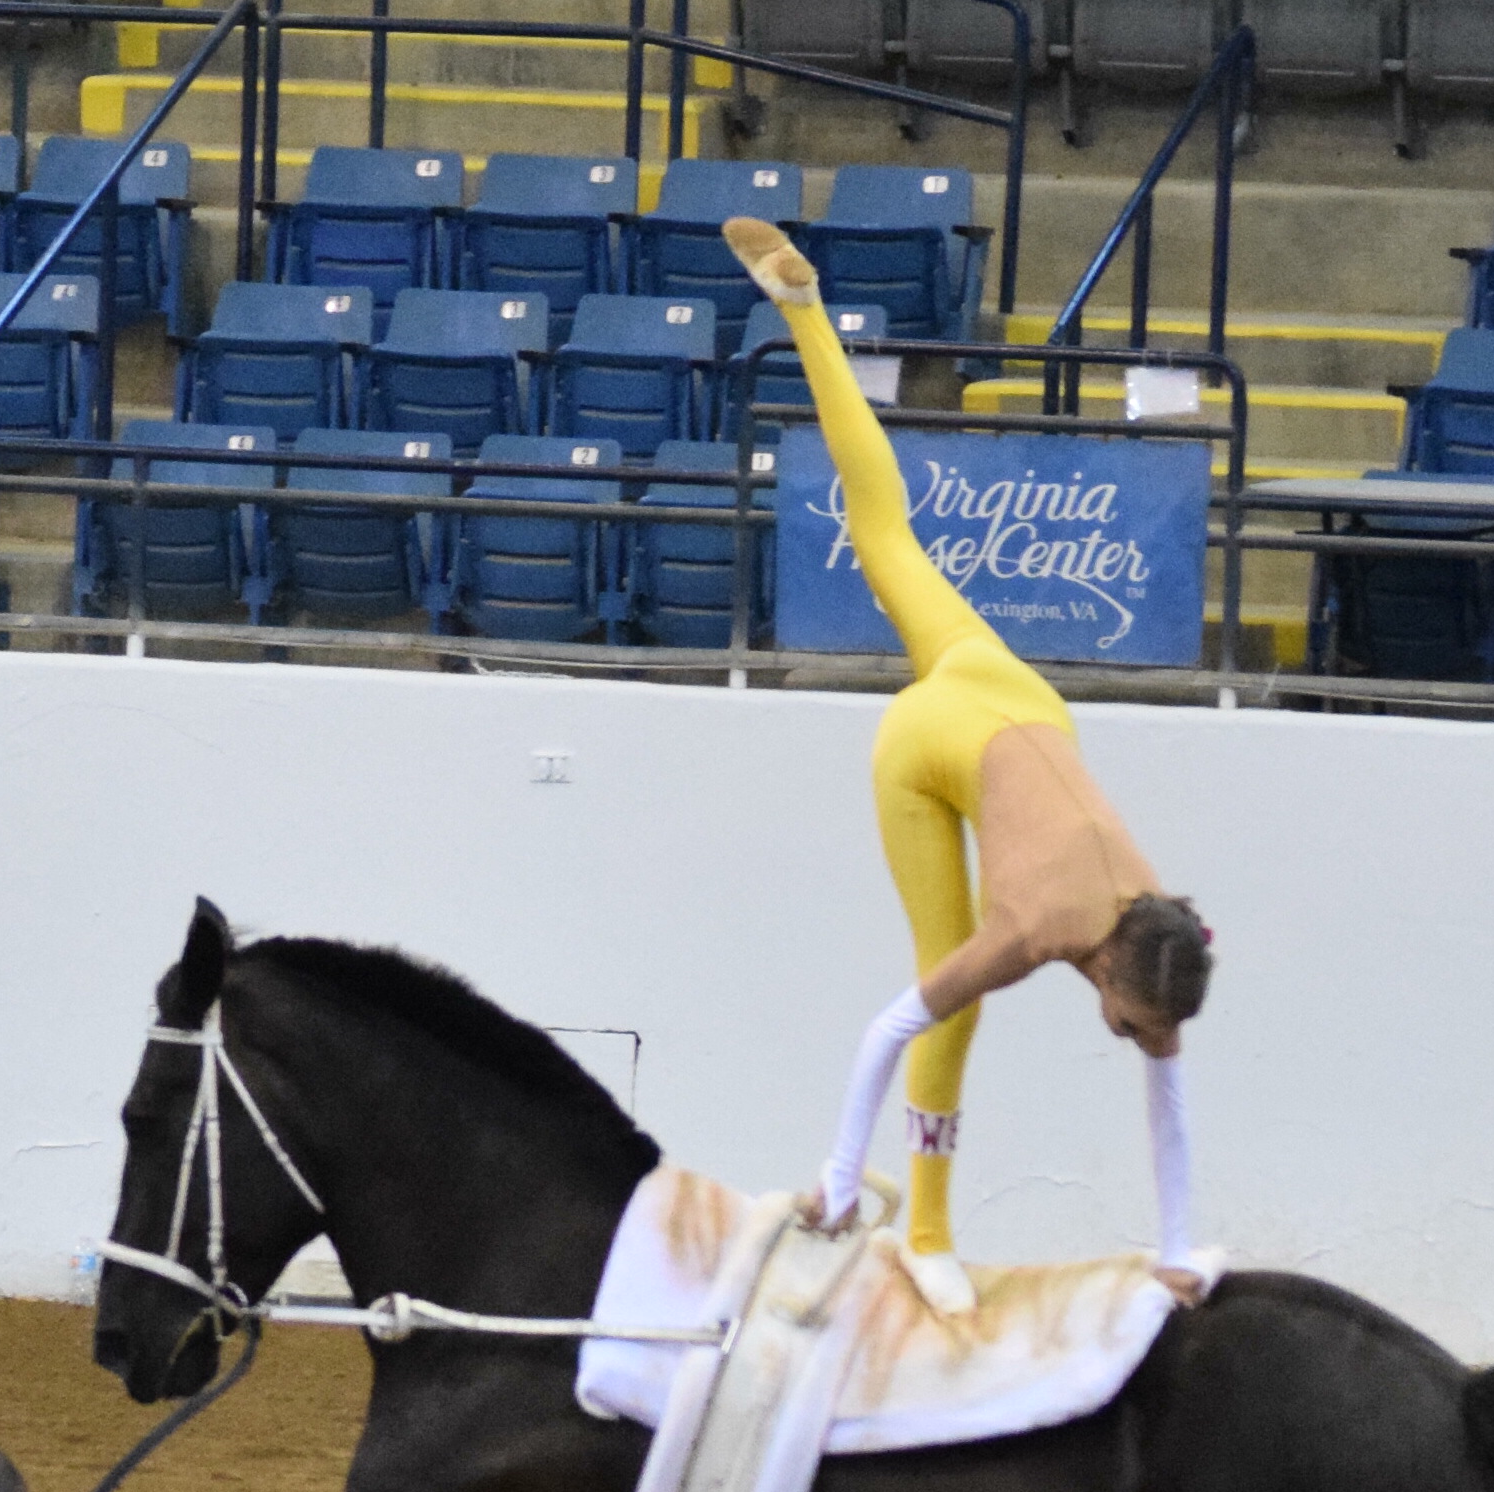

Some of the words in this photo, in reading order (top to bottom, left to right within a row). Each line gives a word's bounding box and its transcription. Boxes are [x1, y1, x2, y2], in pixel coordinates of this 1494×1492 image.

[825, 520, 981, 577] Hse
[987, 522, 1149, 583] Center
[967, 597, 1066, 624] exington,
[1067, 601, 1099, 622] VA
